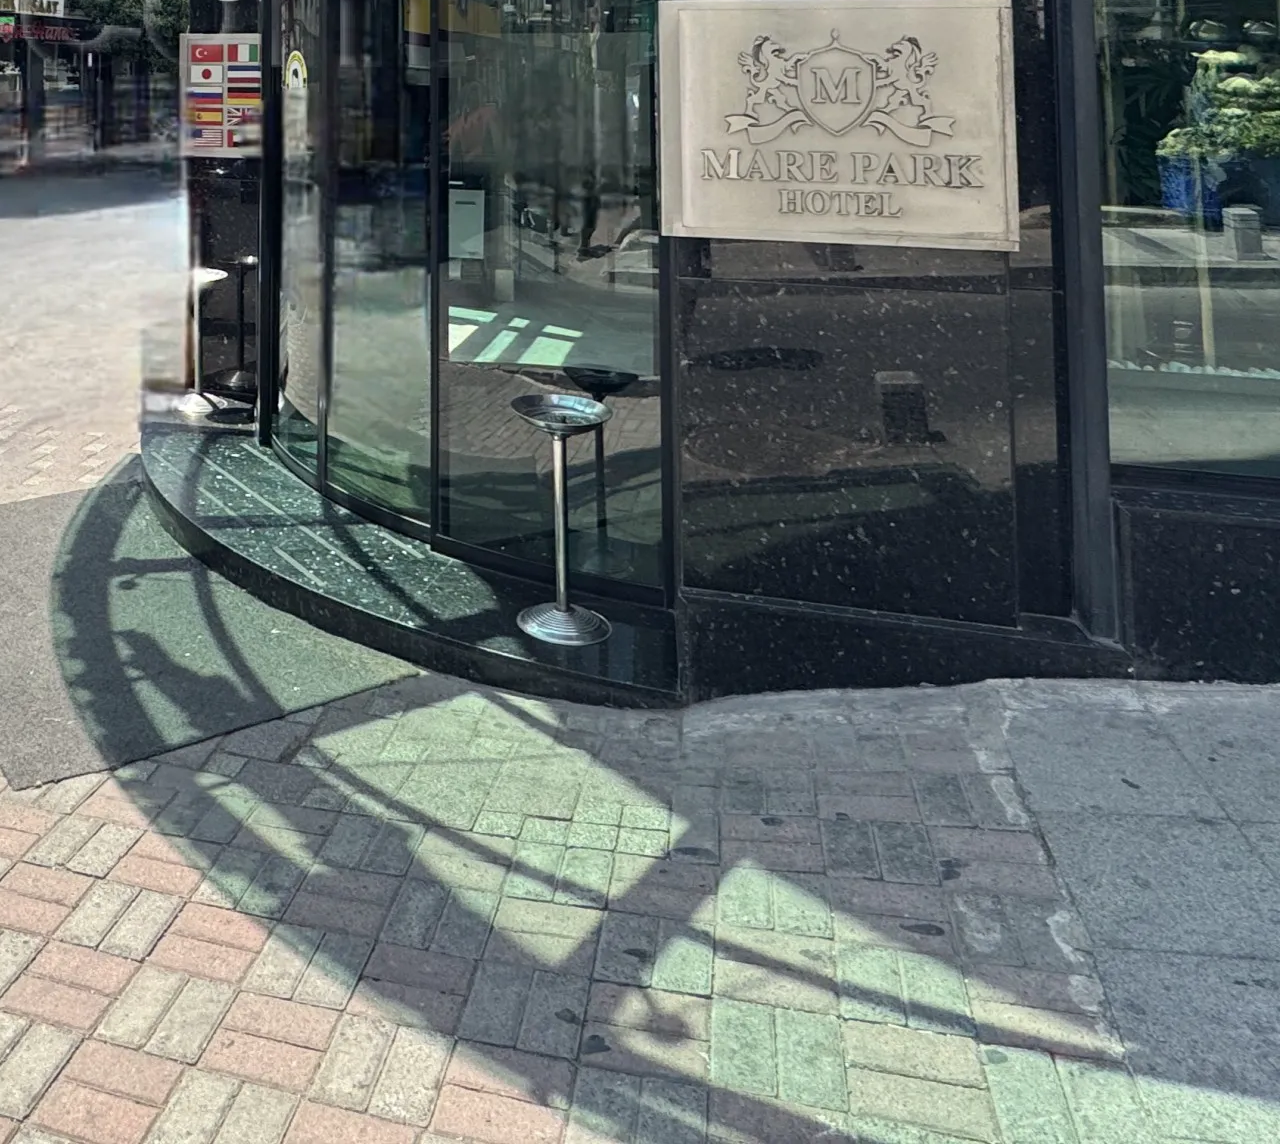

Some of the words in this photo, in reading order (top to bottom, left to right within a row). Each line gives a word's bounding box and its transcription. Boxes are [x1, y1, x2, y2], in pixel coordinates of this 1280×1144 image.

[811, 67, 861, 105] M
[701, 148, 838, 183] MARE
[851, 151, 984, 188] PARK
[779, 189, 903, 218] HOTEL
